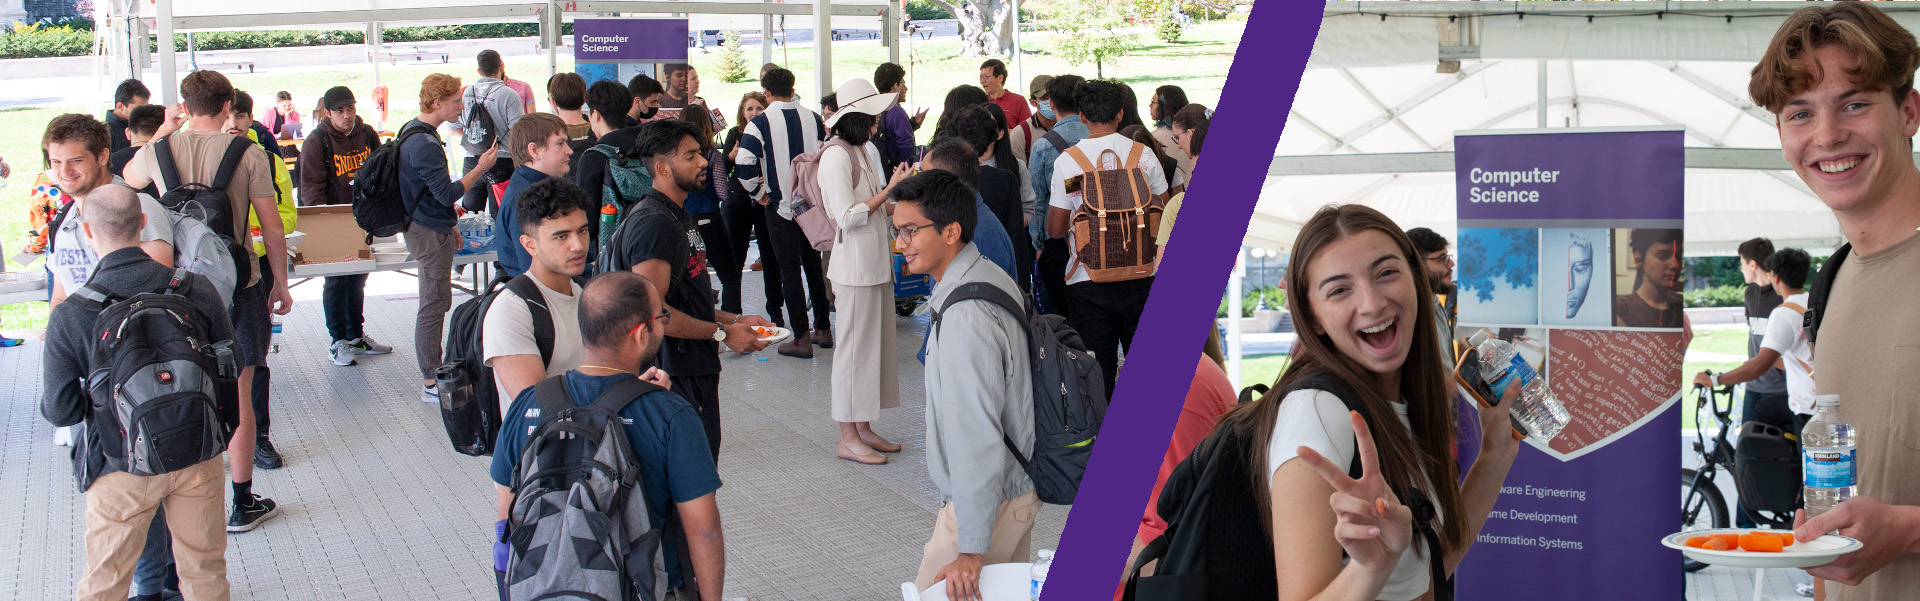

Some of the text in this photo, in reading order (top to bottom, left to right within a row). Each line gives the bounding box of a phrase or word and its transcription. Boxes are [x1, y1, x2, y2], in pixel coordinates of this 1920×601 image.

[582, 34, 629, 44] Computer
[582, 44, 619, 52] Science
[1470, 167, 1560, 187] Computer
[1470, 186, 1540, 203] Science
[1564, 330, 1593, 349] SIMILAR
[1594, 349, 1609, 365] CODE
[1610, 363, 1625, 375] FOR
[1627, 373, 1640, 388] THE
[1499, 485, 1586, 501] ware Engineering
[1487, 509, 1578, 524] ame Development
[1476, 533, 1583, 550] Information Systems
